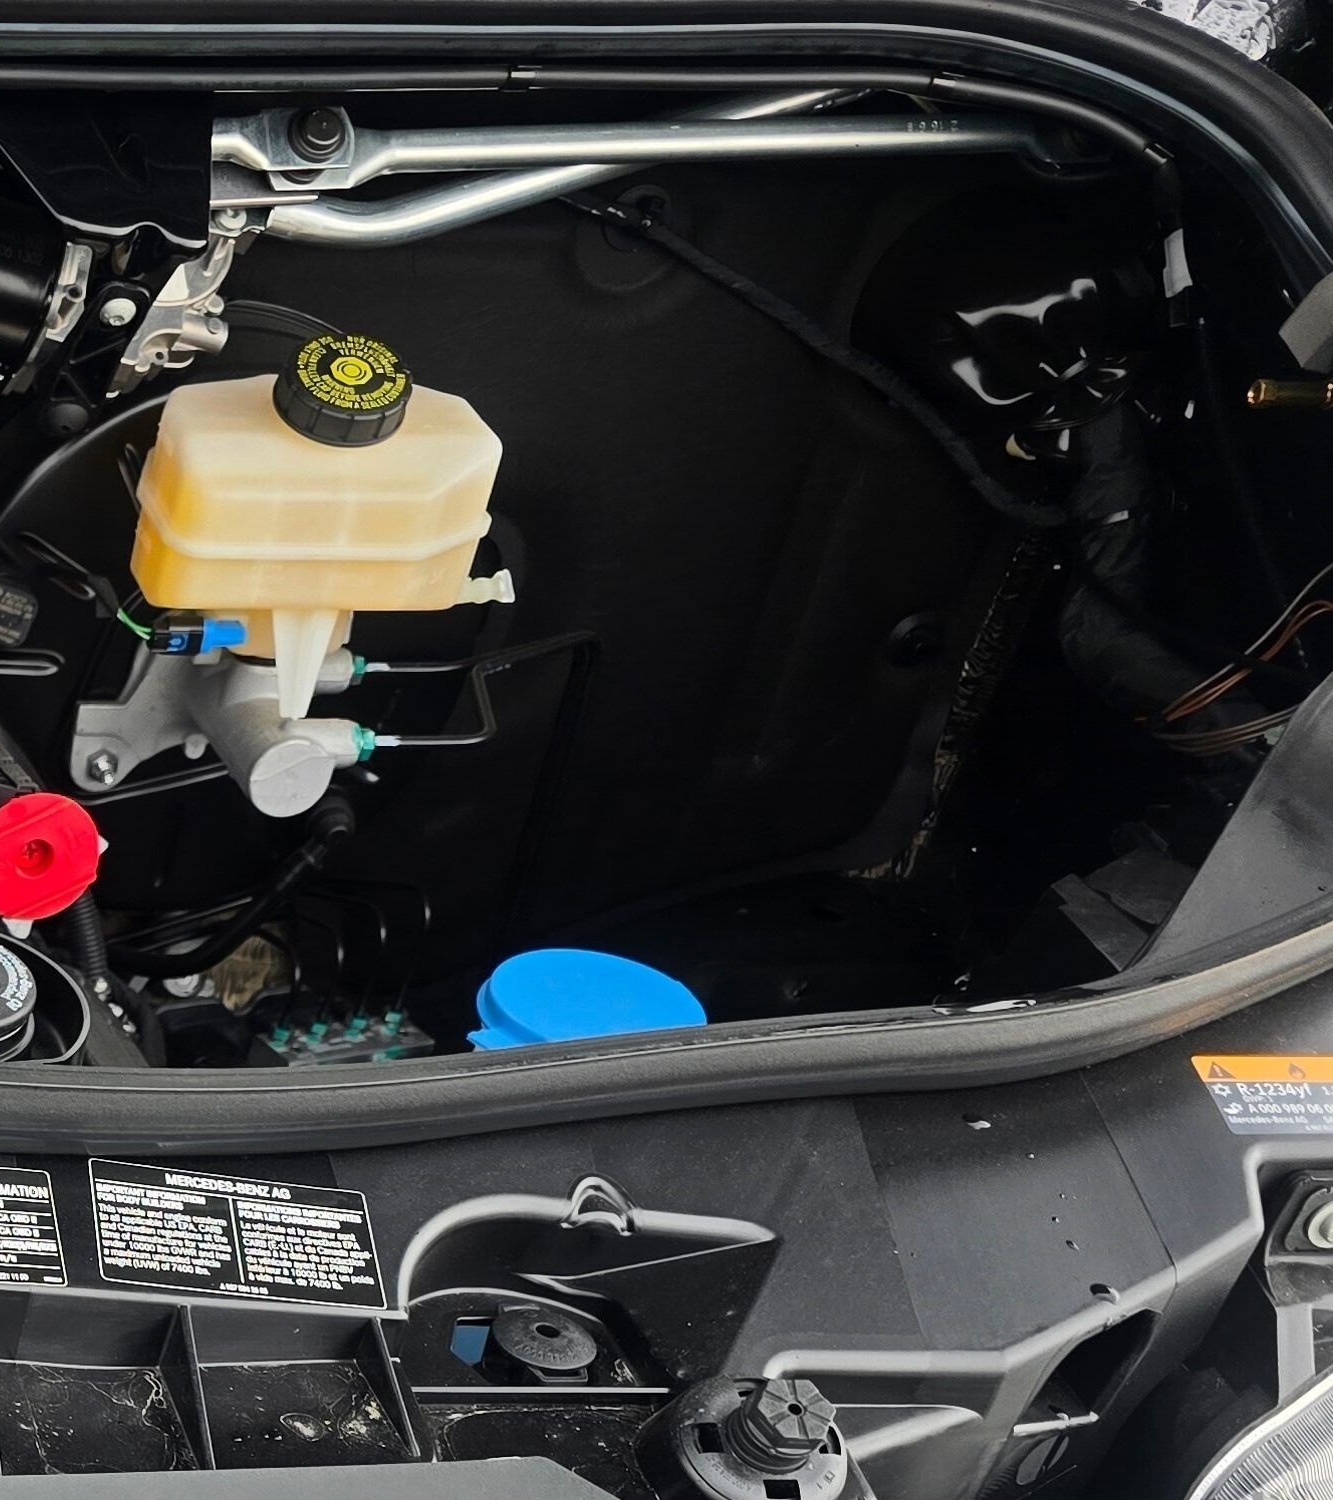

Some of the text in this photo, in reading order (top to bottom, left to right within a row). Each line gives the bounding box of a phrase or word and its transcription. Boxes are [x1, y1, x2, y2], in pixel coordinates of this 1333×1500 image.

[1248, 1104, 1259, 1113] A
[1258, 1104, 1282, 1113] 000
[1282, 1104, 1305, 1113] 989
[164, 1172, 292, 1200] MERCEDES-BENZ AG
